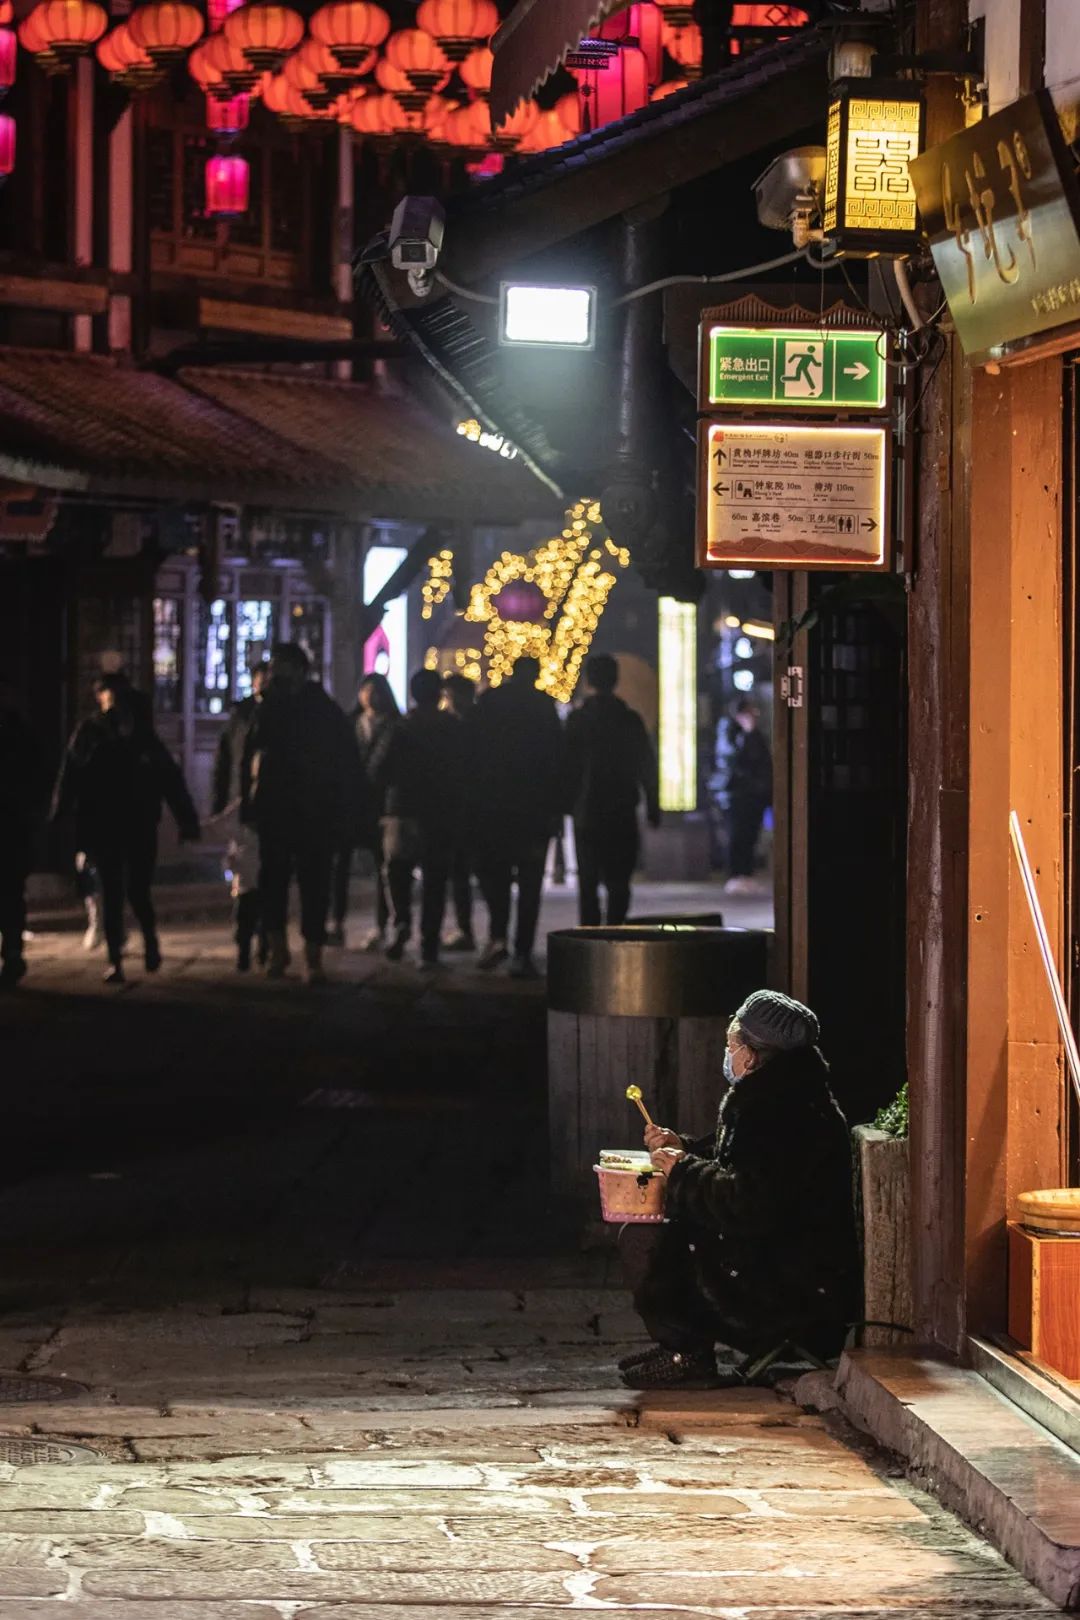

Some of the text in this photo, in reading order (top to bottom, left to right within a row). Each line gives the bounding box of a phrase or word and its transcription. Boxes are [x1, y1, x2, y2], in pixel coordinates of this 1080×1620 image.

[719, 357, 770, 371] 紧急出口
[719, 373, 754, 382] Emergent
[755, 480, 784, 491] 钟家院
[731, 513, 748, 521] 60m
[788, 514, 836, 524] 50m 卫生间
